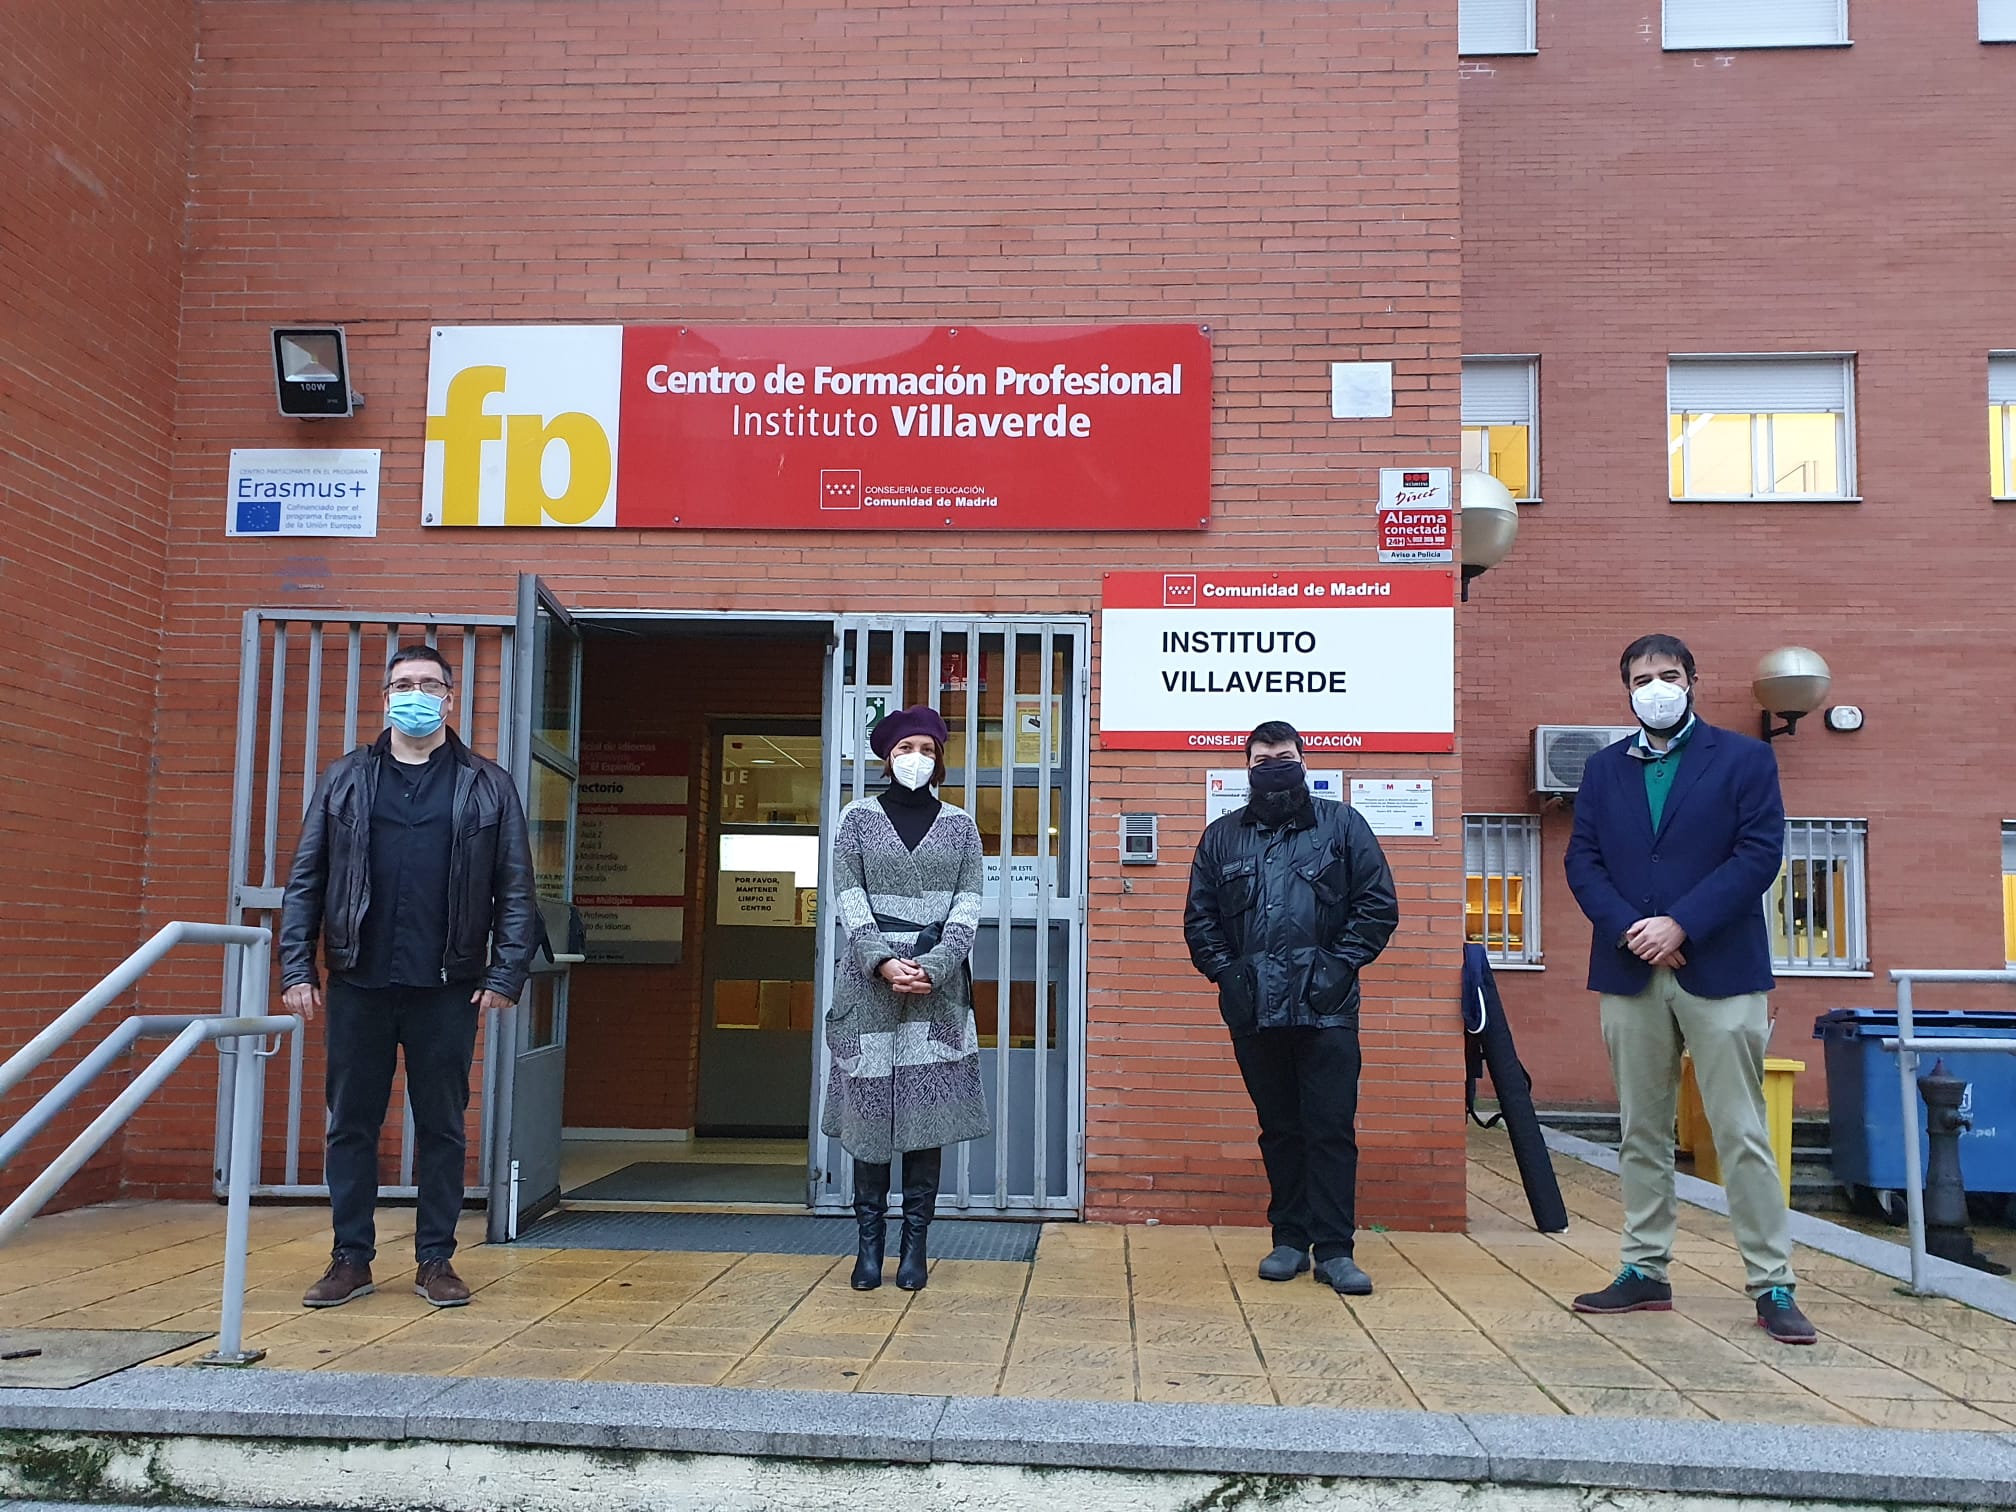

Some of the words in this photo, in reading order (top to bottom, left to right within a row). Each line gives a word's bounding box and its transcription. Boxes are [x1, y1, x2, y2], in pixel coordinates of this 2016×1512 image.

[646, 364, 756, 394] Centro
[764, 363, 805, 394] de
[814, 365, 986, 395] Formación
[995, 363, 1182, 396] Profesional
[301, 383, 326, 391] 100W
[733, 404, 878, 437] Instituto
[891, 403, 1091, 438] Villaverde
[238, 478, 366, 498] Erasmus+
[865, 485, 919, 494] CONSEJERÍA
[920, 486, 932, 494] DE
[934, 485, 985, 494] EDUCACIÓN
[286, 503, 335, 511] Cofinanciado
[864, 497, 933, 507] Comunidad
[936, 497, 952, 507] de
[955, 497, 998, 507] Madrid
[1385, 511, 1446, 524] Alarma
[1385, 524, 1446, 534] conectada
[1202, 584, 1298, 596] Comunidad
[1304, 584, 1325, 596] de
[1330, 583, 1390, 596] Madrid
[1162, 631, 1316, 653] INSTITUTO
[1162, 671, 1346, 693] VILLAVERDE
[1188, 735, 1249, 746] CONSEJE
[578, 782, 624, 793] rectorio
[752, 877, 780, 885] FAVOR,
